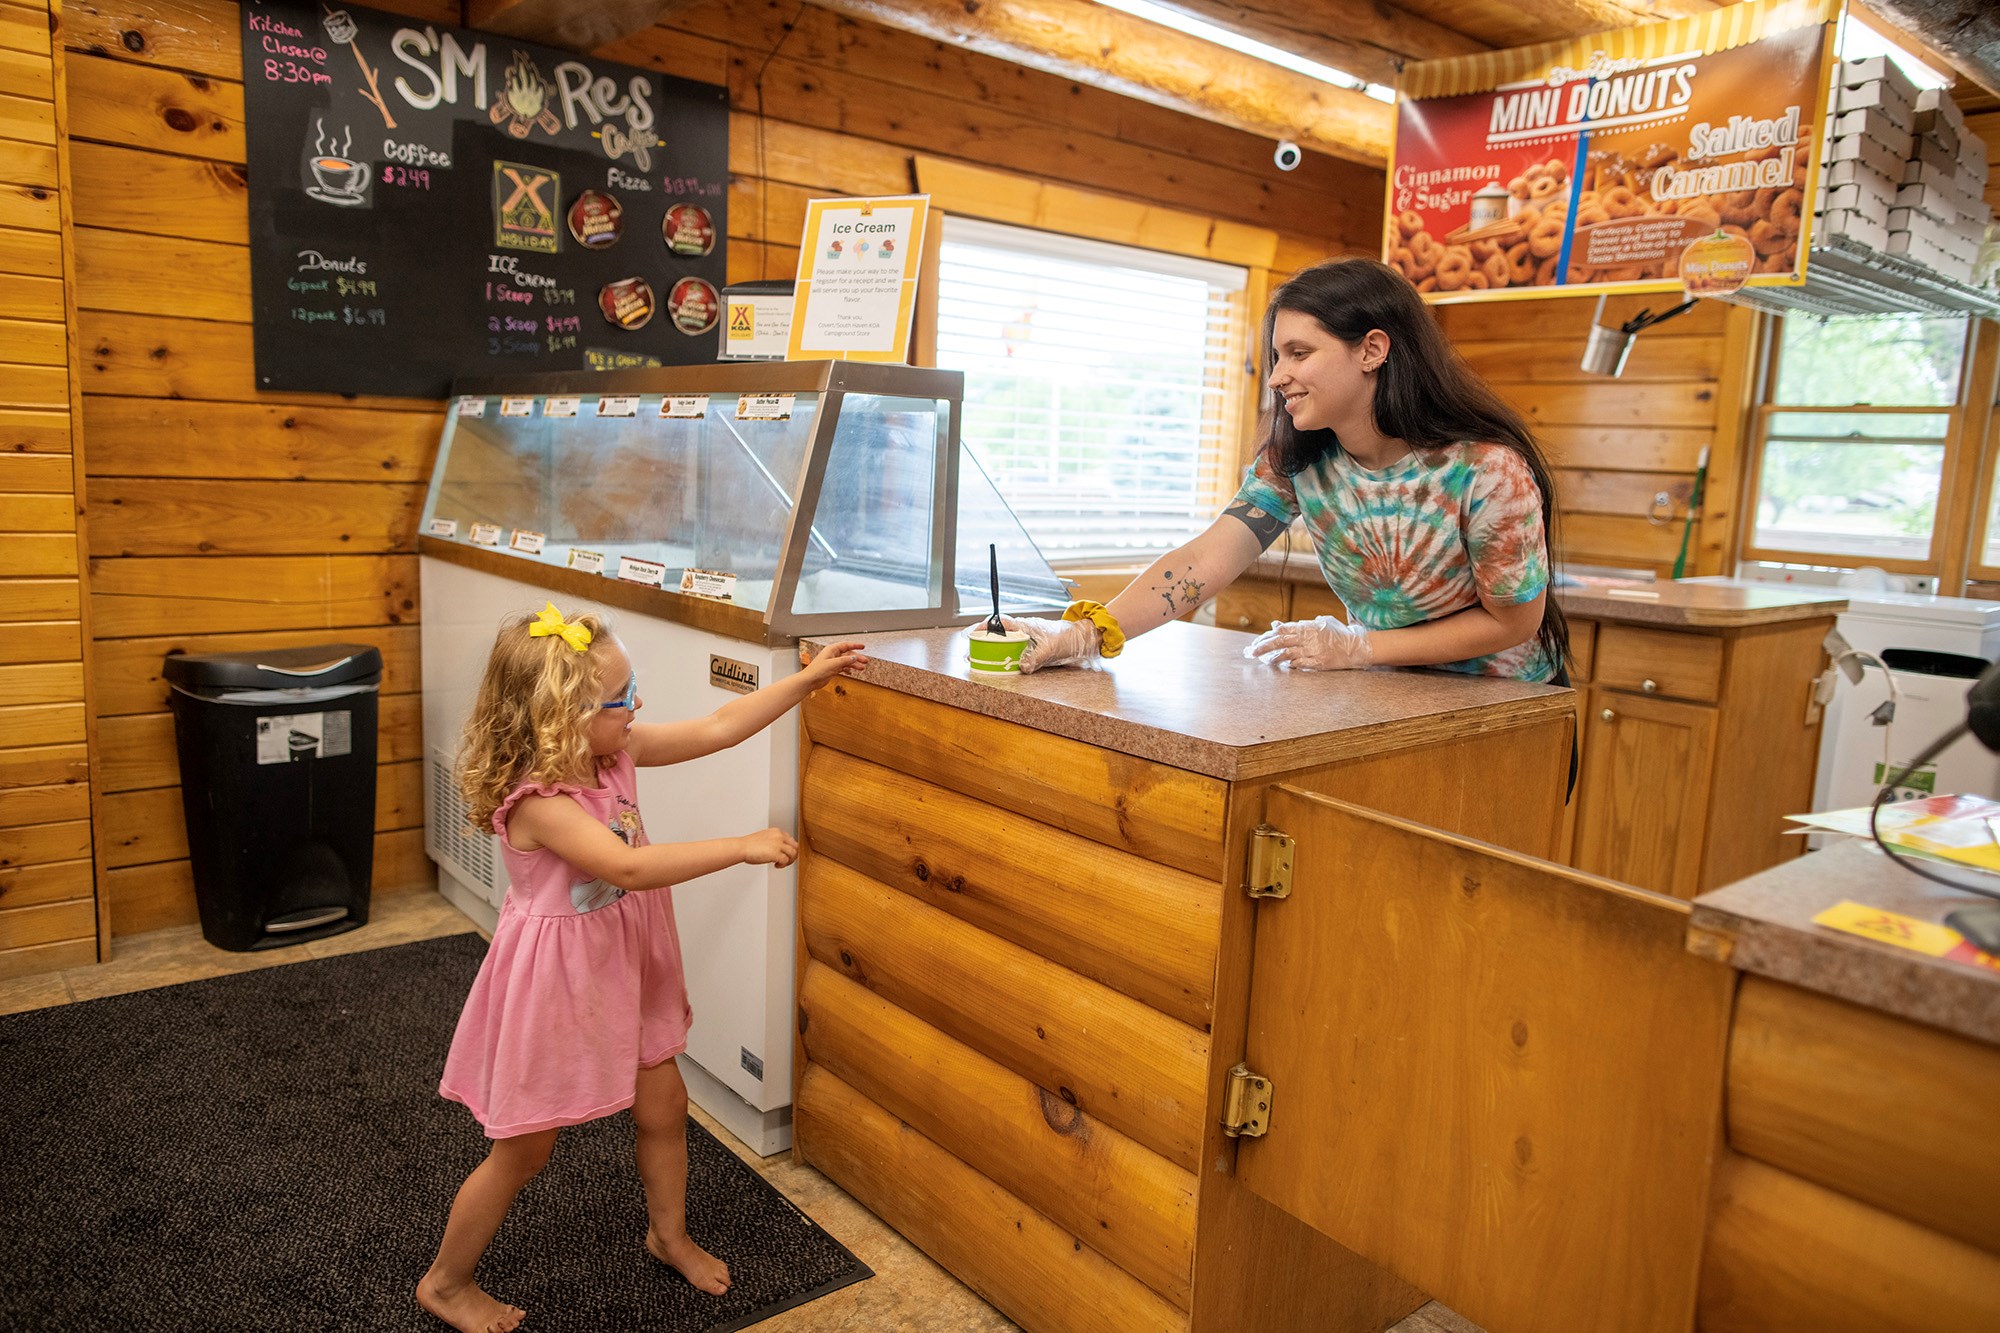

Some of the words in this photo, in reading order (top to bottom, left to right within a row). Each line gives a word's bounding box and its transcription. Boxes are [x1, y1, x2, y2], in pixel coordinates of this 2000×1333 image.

[250, 12, 303, 38] Kitchen
[1489, 88, 1562, 133] MINI
[1566, 64, 1697, 123] DONUTS
[1688, 106, 1801, 160] Salted
[383, 139, 451, 166] Coffee
[607, 167, 653, 191] Pizza
[1394, 164, 1501, 190] Cinnamon
[1651, 147, 1795, 202] Caramel
[1396, 188, 1413, 212] &
[1414, 185, 1472, 213] Sugar
[833, 223, 851, 233] Ice
[855, 222, 896, 233] Cream
[1635, 220, 1686, 233] Combines
[297, 250, 368, 275] Donuts
[488, 254, 519, 275] ICE
[1615, 249, 1665, 261] Sensation
[497, 284, 534, 306] Scoop
[505, 315, 538, 335] Scoop
[711, 658, 756, 686] Coldline
